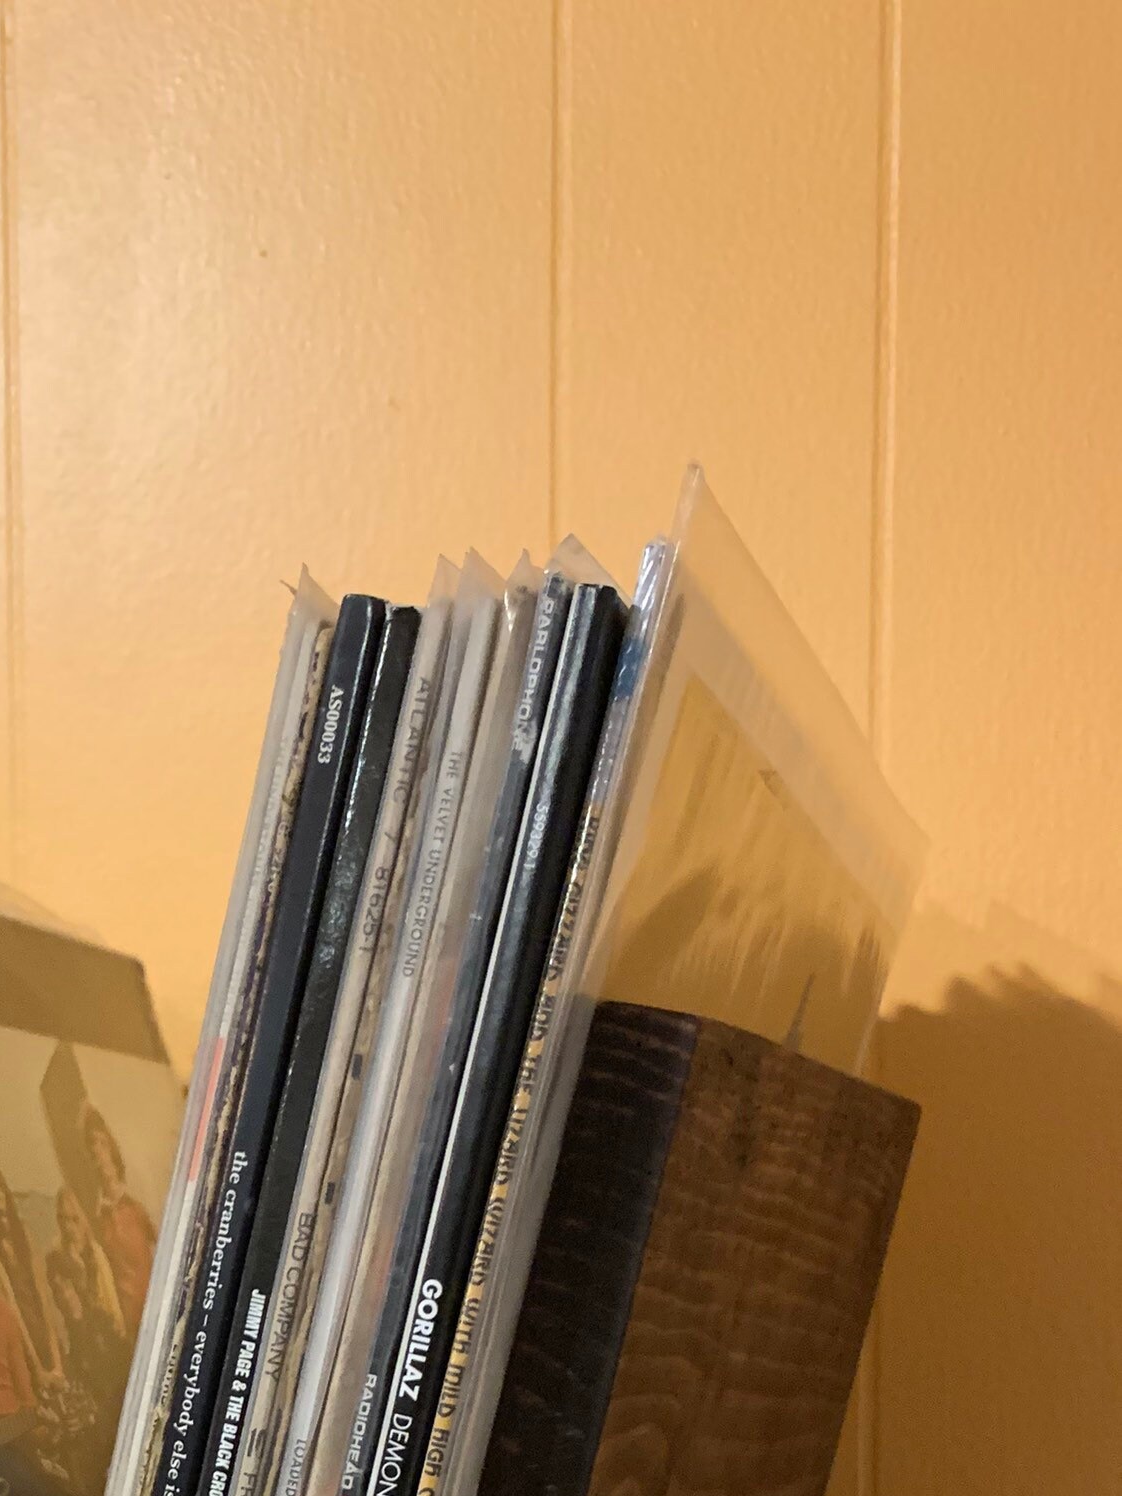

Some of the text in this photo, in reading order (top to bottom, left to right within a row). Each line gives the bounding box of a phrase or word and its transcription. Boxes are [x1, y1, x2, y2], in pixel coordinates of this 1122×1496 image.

[509, 596, 555, 752] PARLOPHONE
[316, 684, 345, 765] AS00033
[359, 676, 433, 952] ATLANTIC 81625-1
[401, 750, 462, 978] THE VELVET UNDERGROUND
[229, 1150, 249, 1185] the
[202, 1188, 240, 1312] cranberries
[469, 1195, 506, 1287] WIZARD
[242, 1288, 267, 1338] JIMMY
[262, 1211, 313, 1382] BAD COMPANY
[452, 1296, 481, 1355] WITH
[235, 1340, 256, 1377] PAGE
[398, 1277, 443, 1401] GORILLAZ
[173, 1330, 211, 1437] everybody
[225, 1394, 244, 1421] THE
[231, 1379, 246, 1392] &
[436, 1363, 465, 1420] MILD
[167, 1439, 188, 1481] else
[215, 1423, 237, 1469] BLACK
[340, 1372, 379, 1490] RADIOHEAD
[423, 1427, 450, 1478] HIGH
